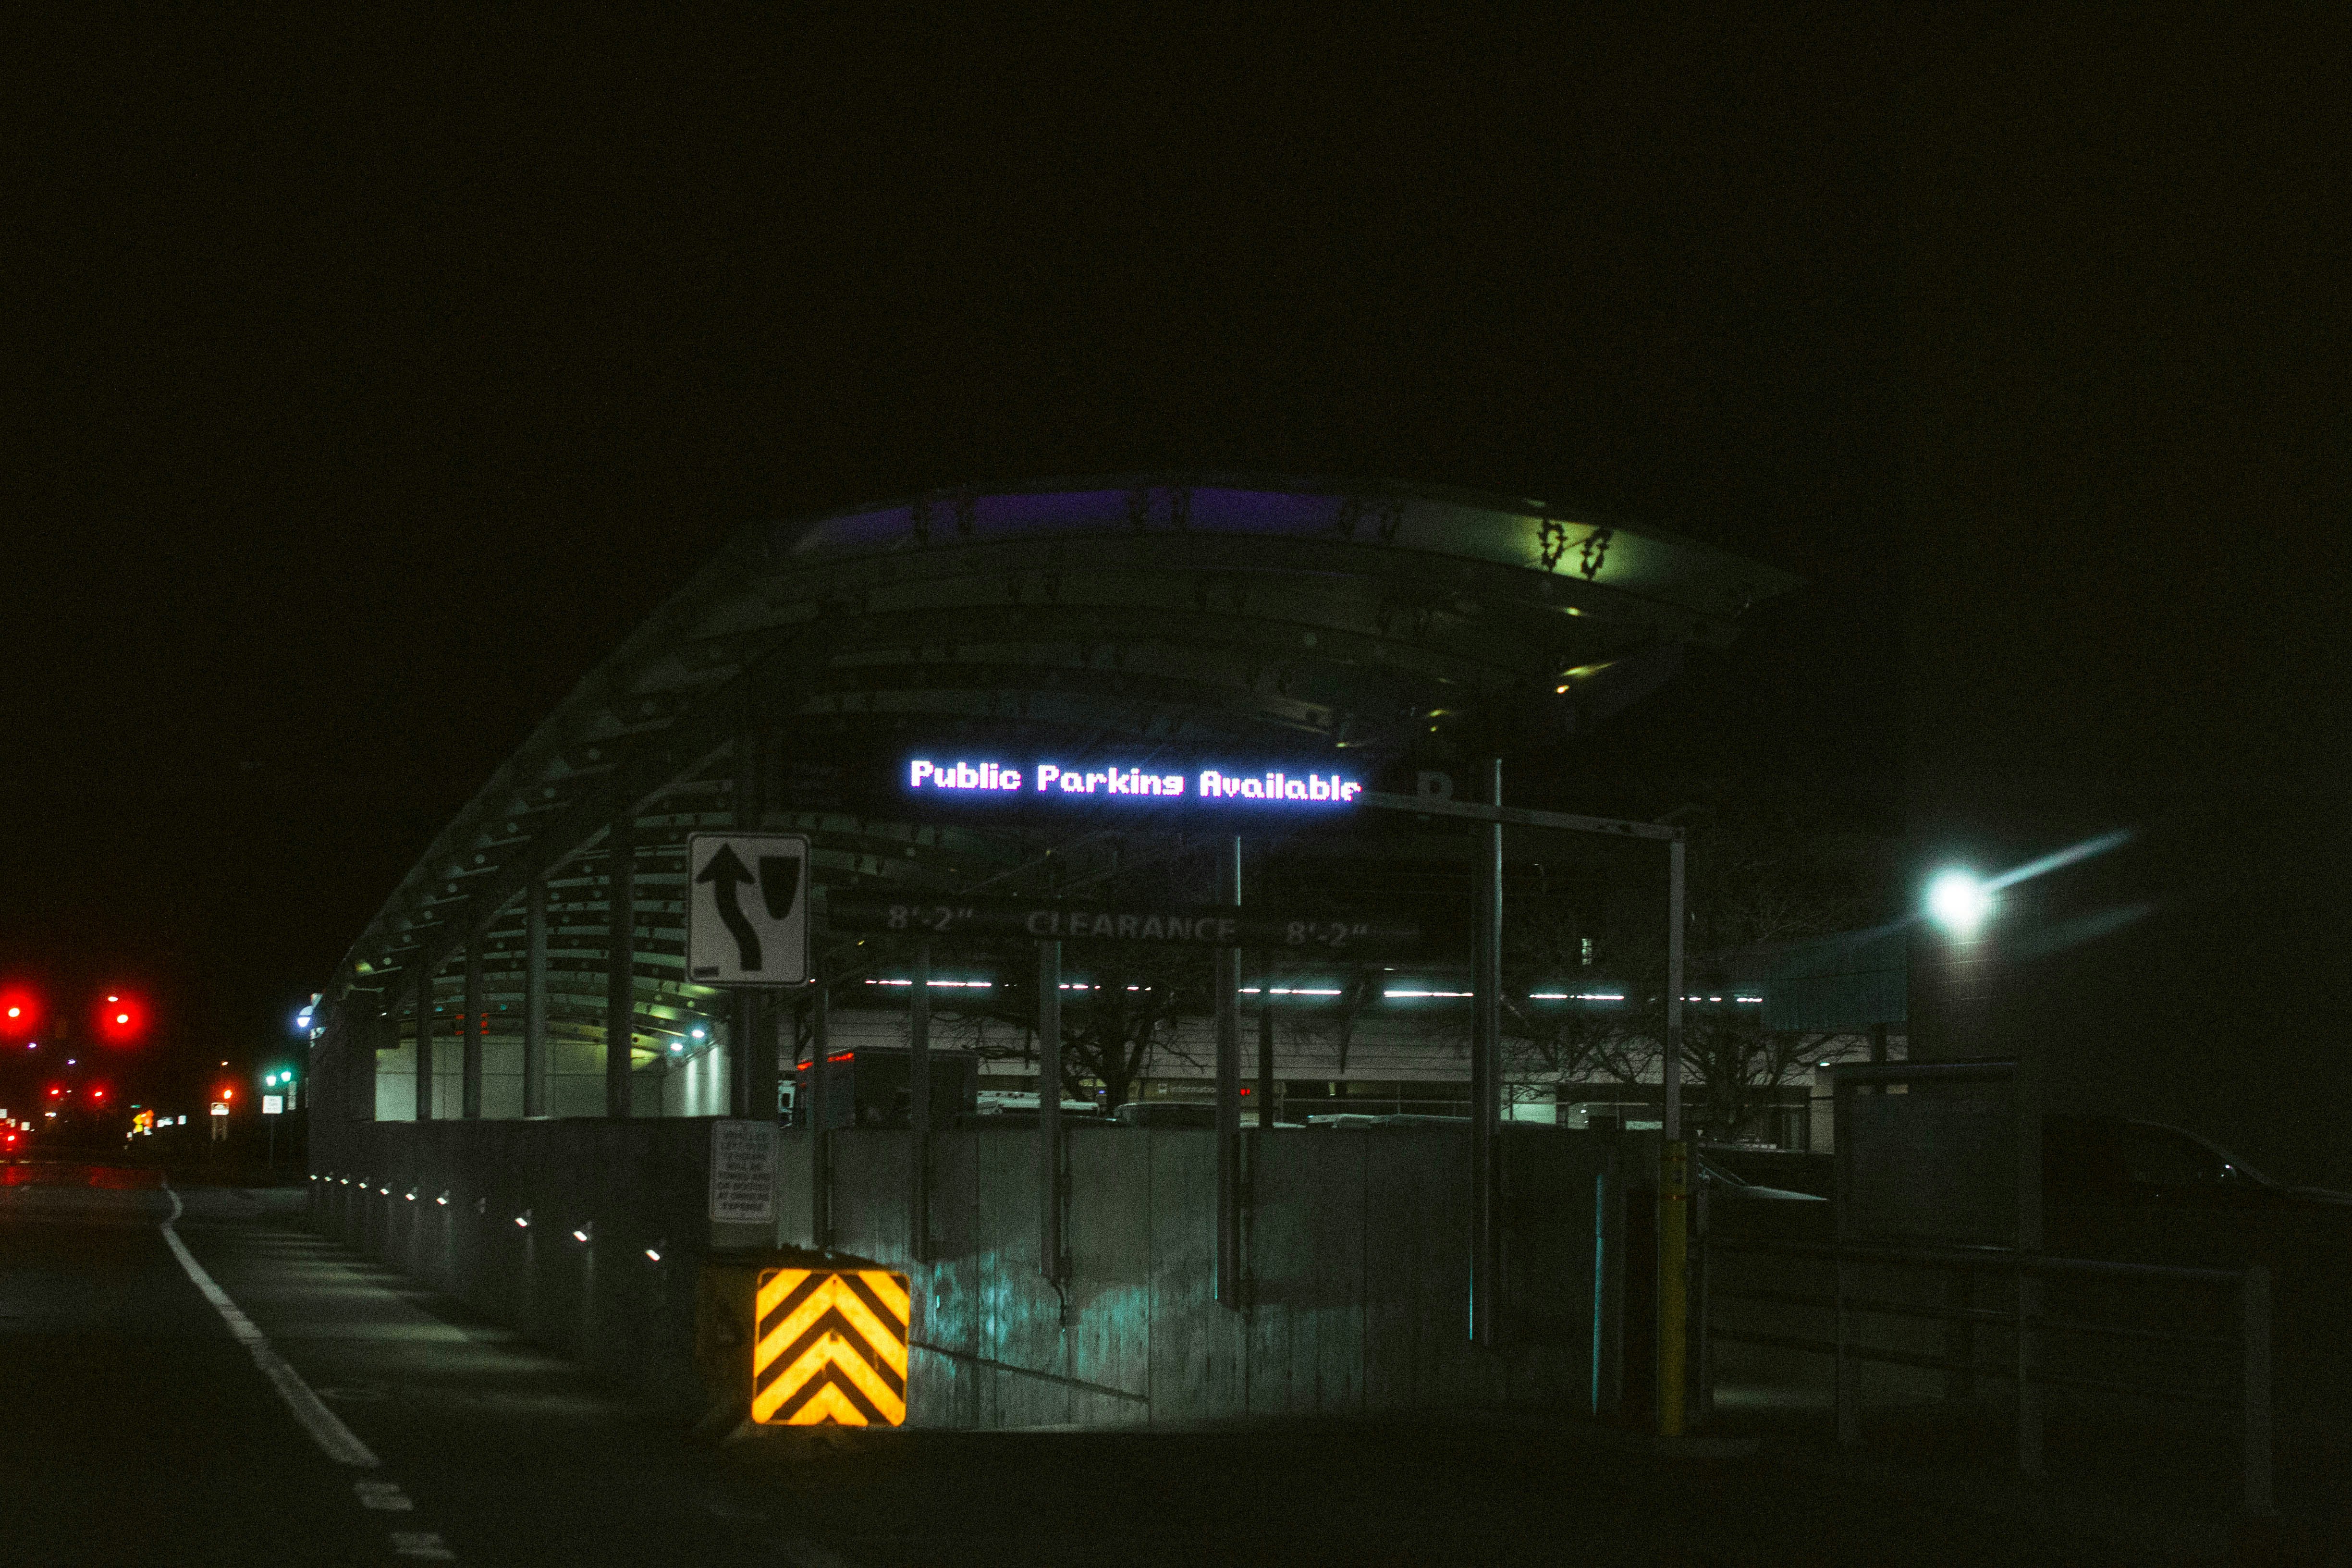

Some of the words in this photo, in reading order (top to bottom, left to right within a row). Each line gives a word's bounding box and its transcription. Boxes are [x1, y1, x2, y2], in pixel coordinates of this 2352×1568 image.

[911, 760, 1022, 791] Public
[1038, 765, 1185, 796] Parking
[1200, 771, 1362, 801] Available
[1417, 770, 1453, 820] P
[1026, 909, 1237, 942] CLEARANCE
